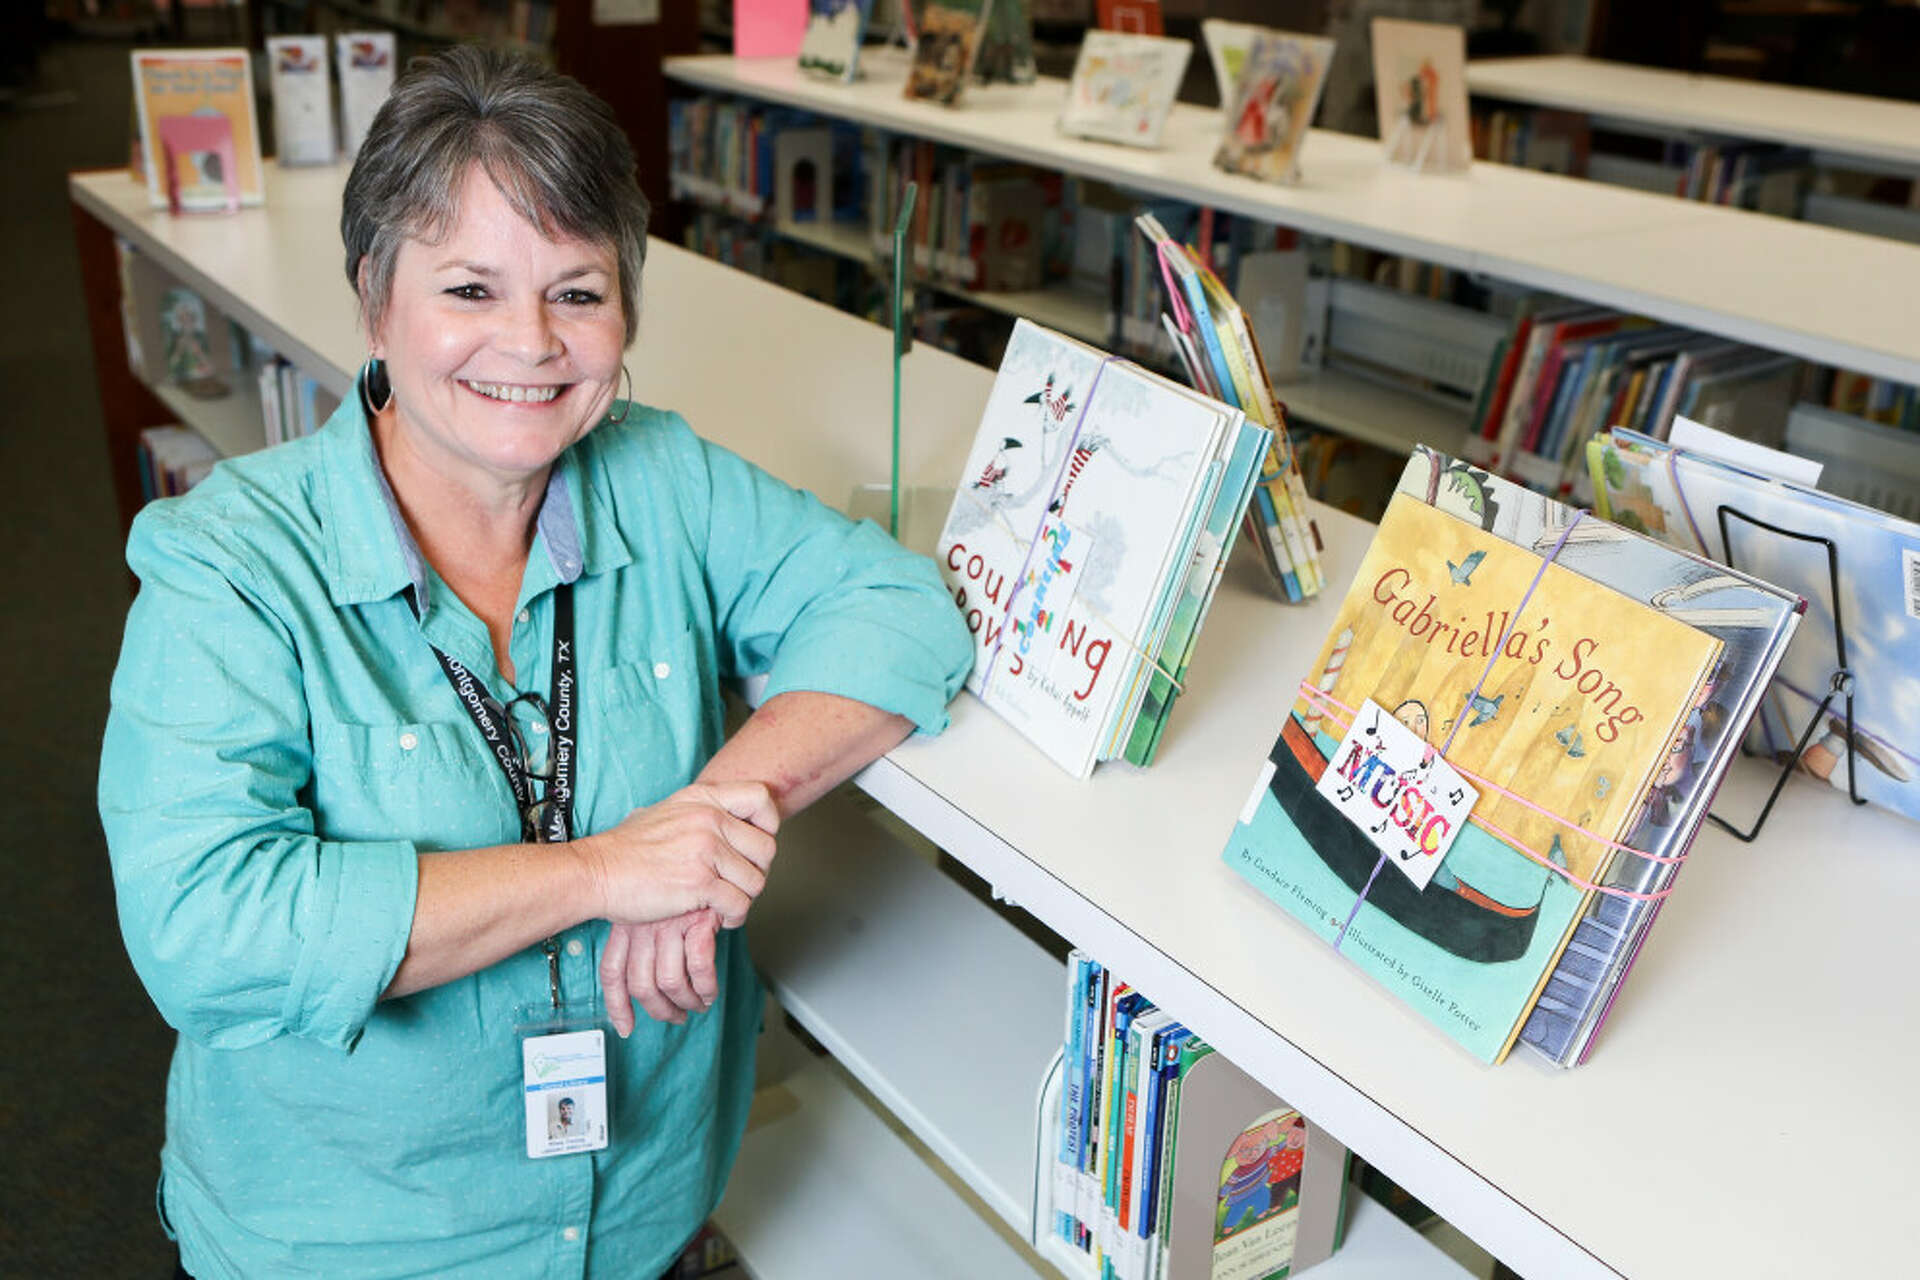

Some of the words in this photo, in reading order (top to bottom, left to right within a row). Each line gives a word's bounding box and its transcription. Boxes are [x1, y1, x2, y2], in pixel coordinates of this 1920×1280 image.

[558, 639, 571, 663] TX
[1373, 568, 1550, 665] Gabriella's
[1552, 637, 1644, 743] Song
[554, 668, 574, 731] County,
[1337, 740, 1452, 856] MUSIC
[1447, 1001, 1482, 1032] Potter
